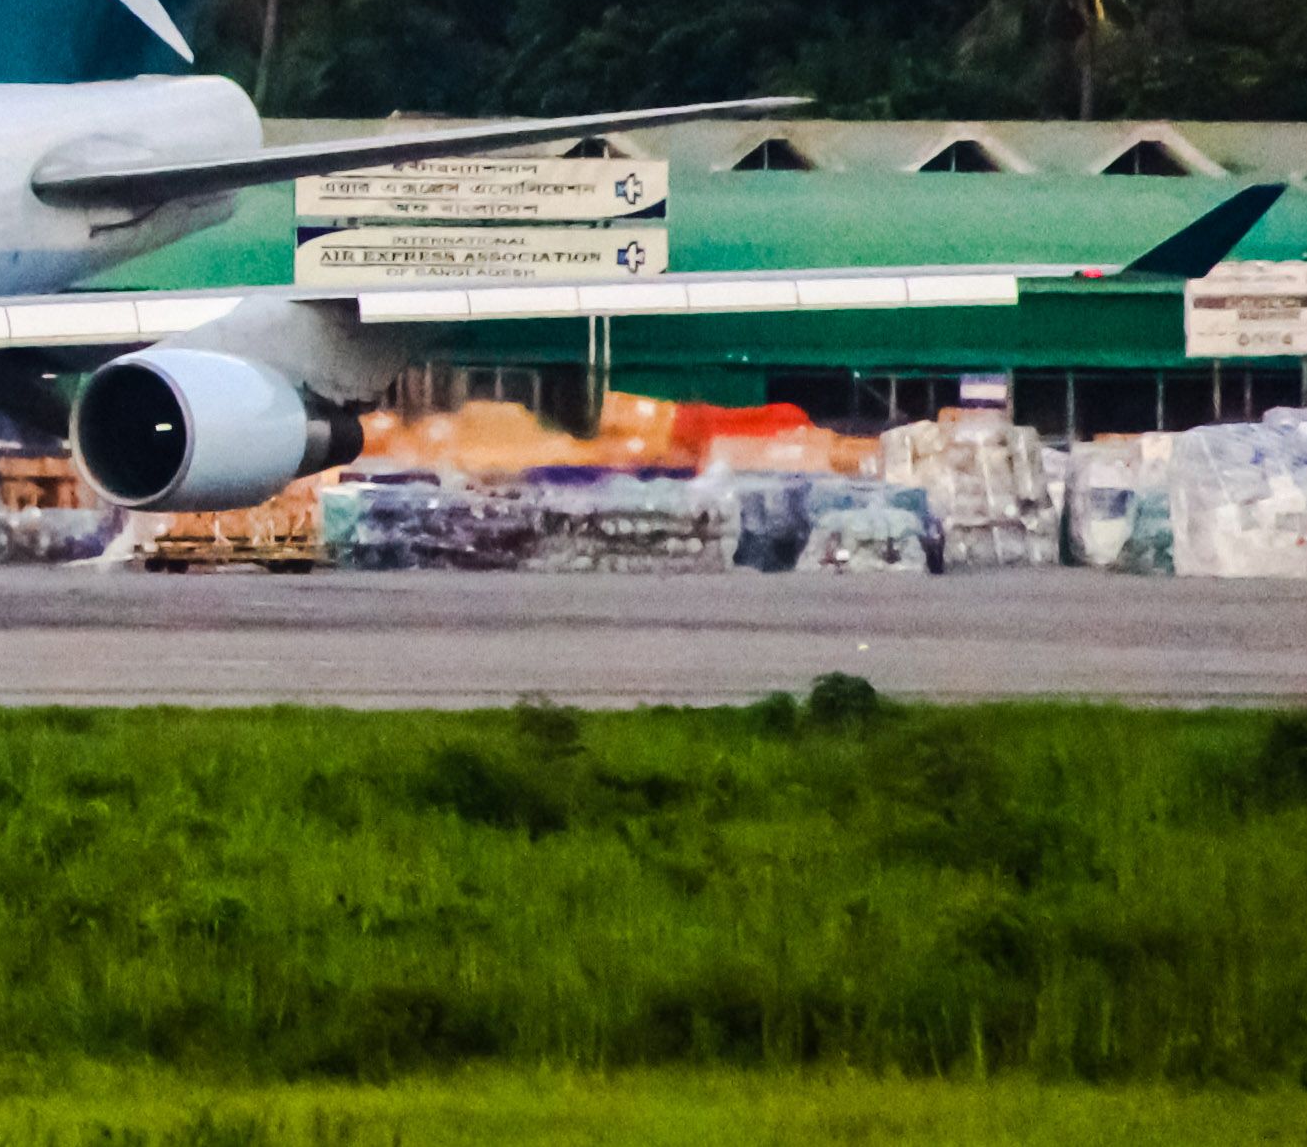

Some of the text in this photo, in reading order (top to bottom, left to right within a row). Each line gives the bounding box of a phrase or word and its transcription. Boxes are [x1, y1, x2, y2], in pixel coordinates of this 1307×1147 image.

[321, 251, 601, 263] AIR EXPRESS ASSOCIATION
